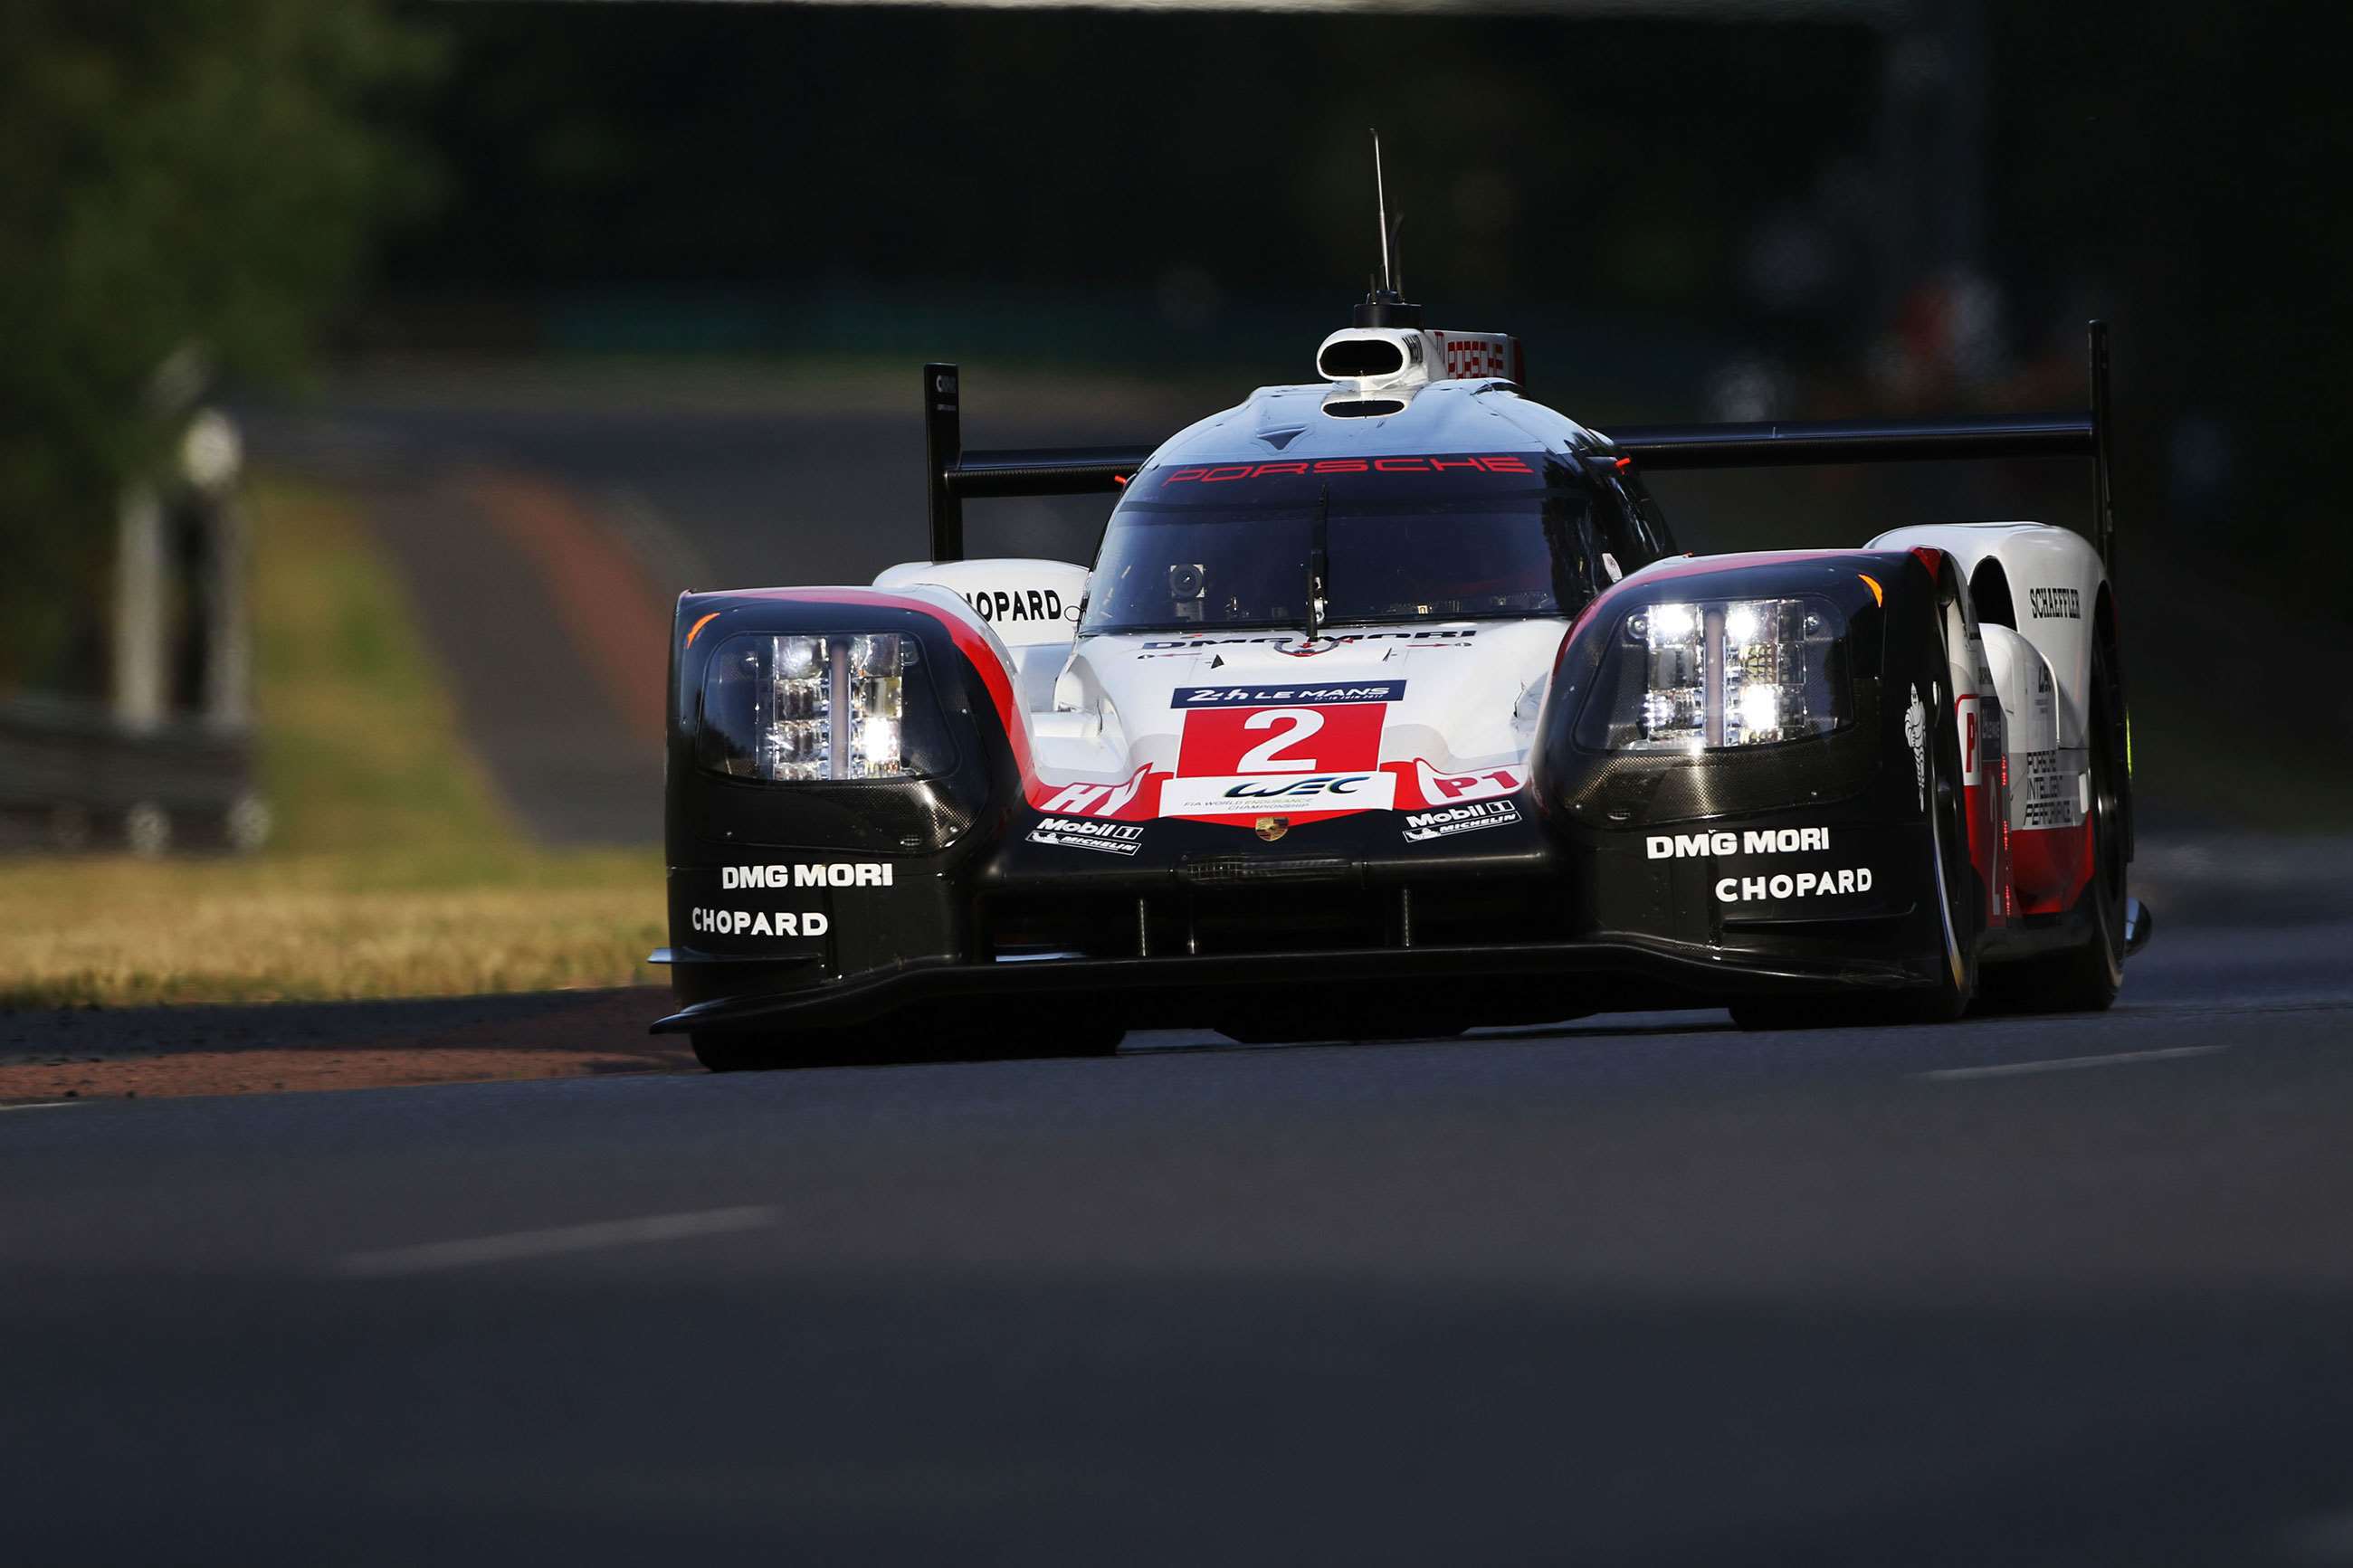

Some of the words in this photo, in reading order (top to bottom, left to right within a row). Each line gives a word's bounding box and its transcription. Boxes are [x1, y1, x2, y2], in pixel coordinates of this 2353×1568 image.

[1161, 457, 1536, 487] PORSCHE
[967, 590, 1062, 622] OPARD
[2030, 588, 2081, 619] SCHAEFFLER
[1254, 690, 1291, 699] LE
[1299, 687, 1390, 698] MANS
[1237, 708, 1324, 773] 2
[1040, 768, 1148, 816] HY
[1224, 776, 1371, 798] WEC
[1434, 771, 1519, 798] P1
[1037, 818, 1117, 837] Mobil
[1405, 804, 1485, 828] Mobil
[1439, 813, 1517, 833] MICHELIN
[1060, 836, 1137, 851] MICHELIN
[1646, 832, 1738, 860] DMG
[1743, 827, 1830, 854] MORI
[722, 865, 788, 889] DMG
[794, 863, 893, 887] MORI
[1715, 868, 1872, 902] CHOPARD
[692, 907, 828, 936] CHOPARD
